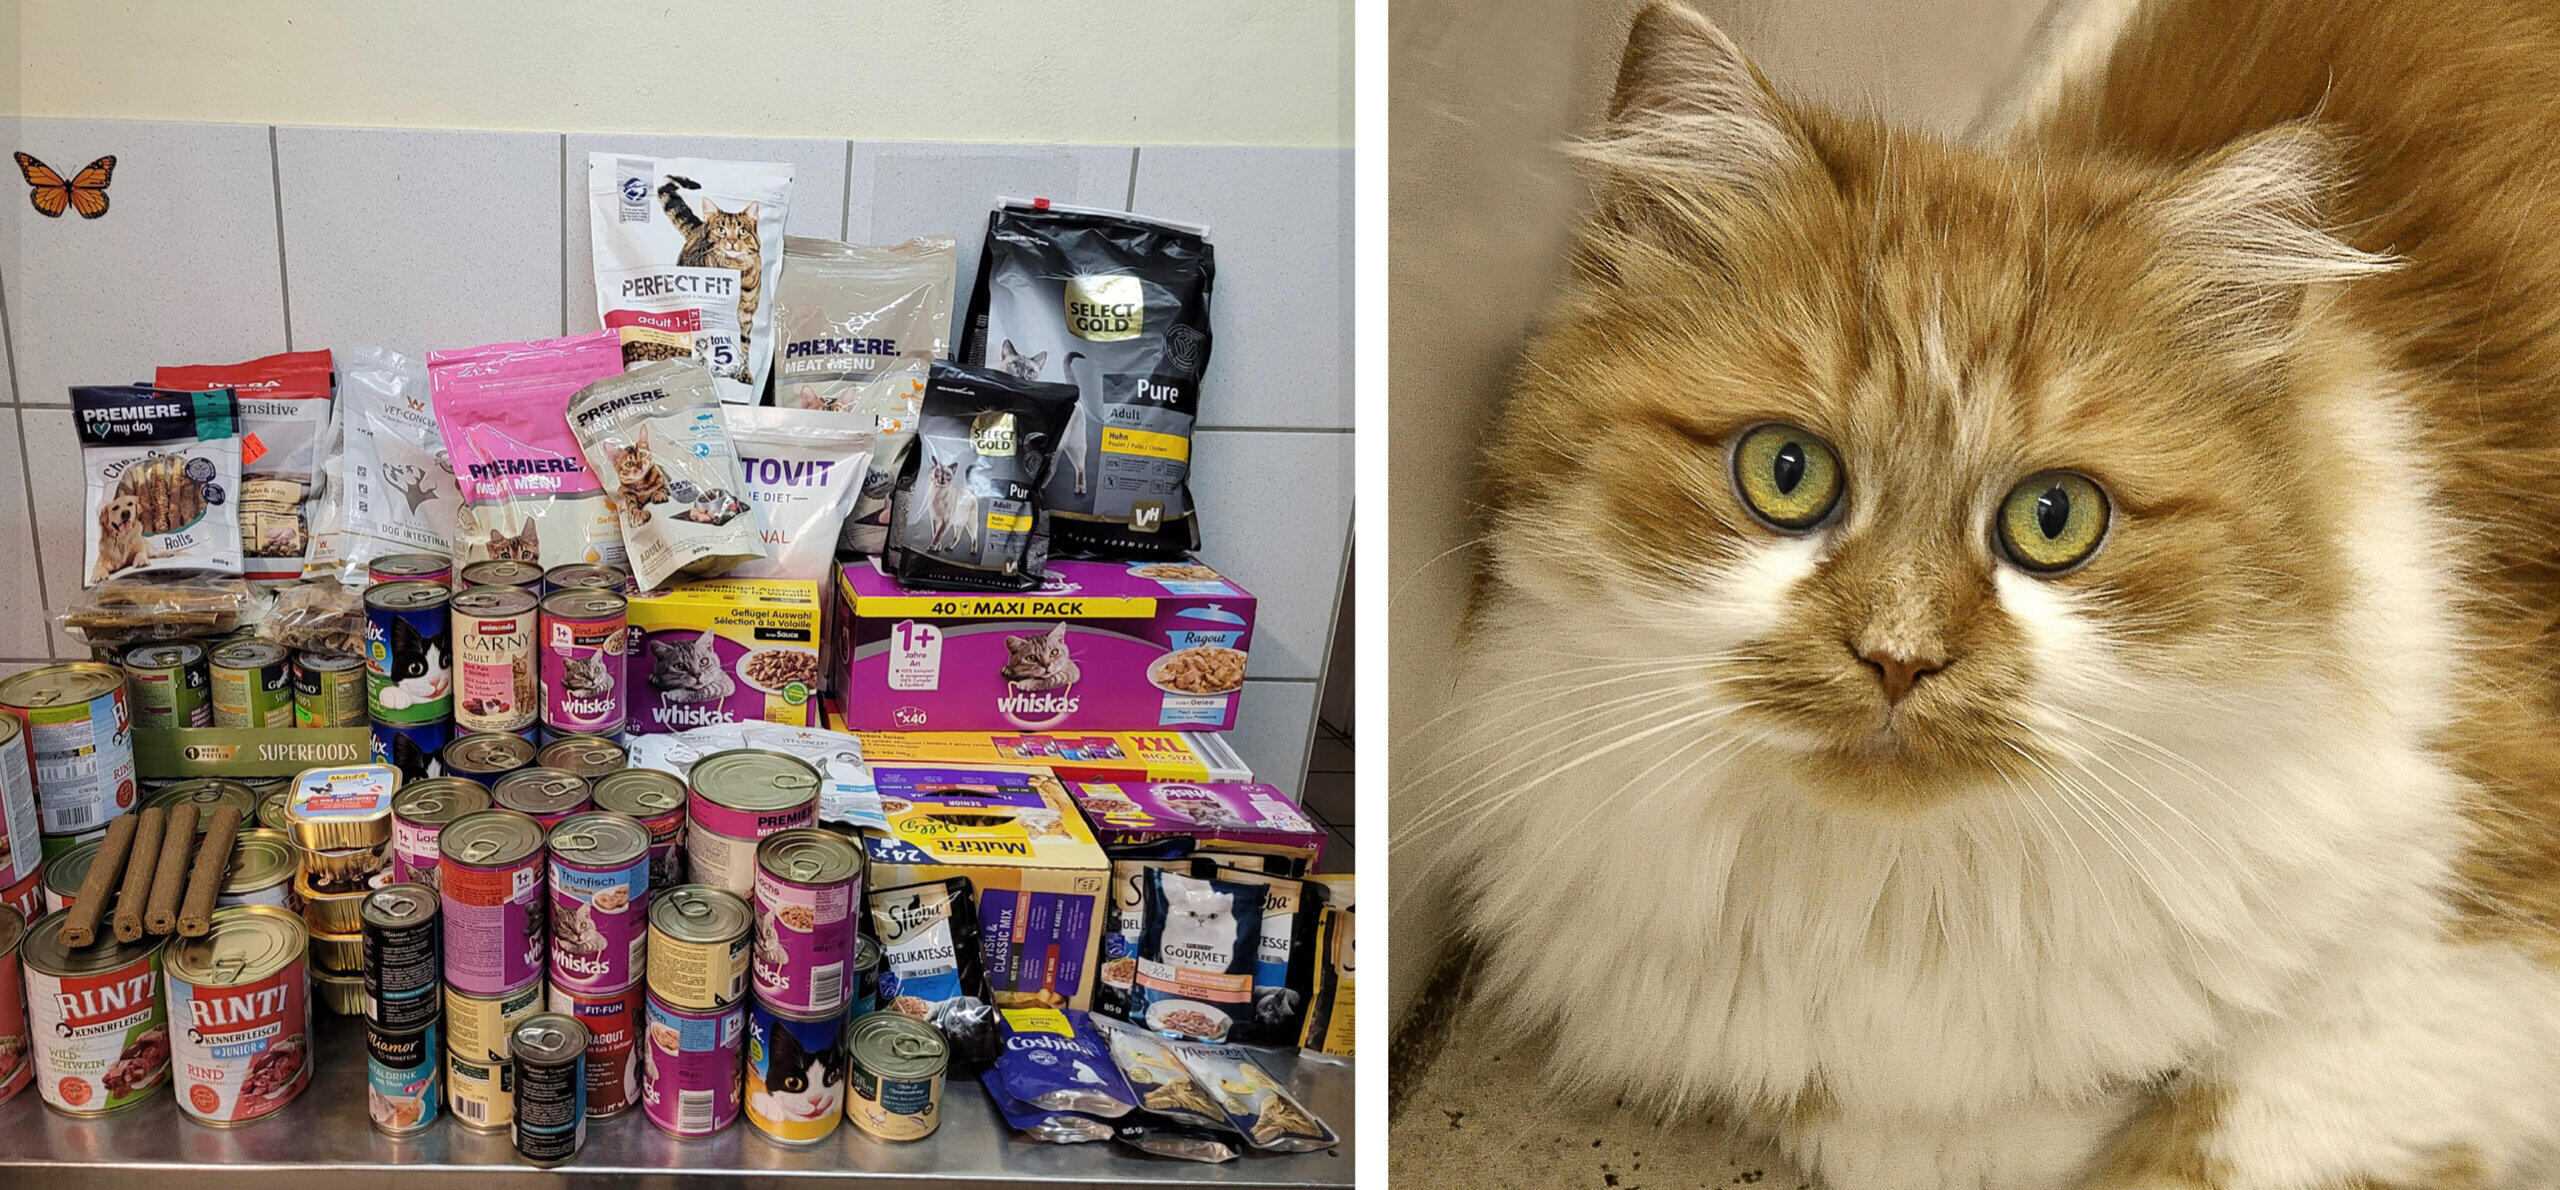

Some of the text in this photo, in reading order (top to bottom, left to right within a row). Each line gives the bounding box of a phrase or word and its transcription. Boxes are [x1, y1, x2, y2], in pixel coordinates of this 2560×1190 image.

[622, 274, 733, 297] PERFECT FIT
[1070, 301, 1135, 318] SELECT
[638, 315, 672, 328] adult
[675, 317, 689, 328] 1+
[1076, 318, 1130, 333] GOLD
[713, 345, 734, 365] 5
[786, 338, 901, 359] PREMIERE.
[785, 358, 826, 375] MEAT
[1137, 378, 1180, 404] Pure
[83, 404, 187, 422] PREMIERE.
[240, 402, 299, 416] ensitive
[576, 388, 671, 427] PREMIERE.
[1110, 408, 1140, 420] Adult
[113, 423, 131, 435] my
[132, 421, 154, 435] dog
[974, 428, 1015, 441] SELECT
[1108, 431, 1129, 440] Huhn
[977, 440, 1011, 451] GOLD
[740, 456, 836, 487] TOVIT
[763, 491, 792, 503] DIET
[1009, 483, 1029, 500] Pur
[164, 532, 194, 550] Rolls
[381, 524, 451, 549] DOG INTESTINAL
[730, 608, 813, 620] Geflügel Auswahl
[931, 602, 1084, 615] 40 MAXI PACK
[480, 623, 515, 632] animonda
[713, 616, 756, 627] Sélection
[766, 619, 776, 627] la
[778, 620, 812, 628] Volaille
[556, 626, 568, 638] 1+
[896, 620, 935, 652] 1+
[1184, 632, 1227, 648] Ragout
[463, 632, 531, 651] CARNY
[462, 652, 490, 663] ADULT
[904, 651, 927, 660] Jahre
[561, 698, 616, 715] whiskas
[997, 694, 1080, 714] whiskas
[651, 705, 735, 727] whiskas
[902, 713, 928, 725] x40
[259, 743, 358, 762] SUPERFOODS
[1129, 736, 1188, 754] XXL
[899, 816, 958, 835] Jelly
[398, 829, 410, 842] 1+
[416, 832, 438, 843] Lac
[891, 849, 921, 862] 24
[937, 840, 1027, 855] MultiFit
[516, 872, 530, 885] 1+
[561, 869, 616, 888] Thunfisch
[984, 934, 997, 958] FISH
[994, 908, 1013, 973] CLASSIC MIX
[551, 945, 610, 974] whiskas
[889, 945, 955, 965] DELIKATESSE
[1164, 943, 1227, 964] GOURMET
[908, 967, 942, 977] IN GELEE
[53, 970, 158, 1021] RINTI
[186, 984, 288, 1028] RINTI
[585, 1003, 623, 1015] FIT-FUN
[1103, 1003, 1114, 1012] 85
[75, 1010, 151, 1038] KENNERFLEISCH
[205, 1024, 279, 1046] KENNERFLEISCH
[367, 1030, 420, 1053] Miamor
[588, 1029, 625, 1045] RAGOUT
[49, 1047, 81, 1060] WILD-
[220, 1043, 258, 1058] JUNIOR
[50, 1058, 106, 1070] SCHWEIN
[187, 1063, 225, 1081] RIND
[1122, 1126, 1135, 1136] 85
